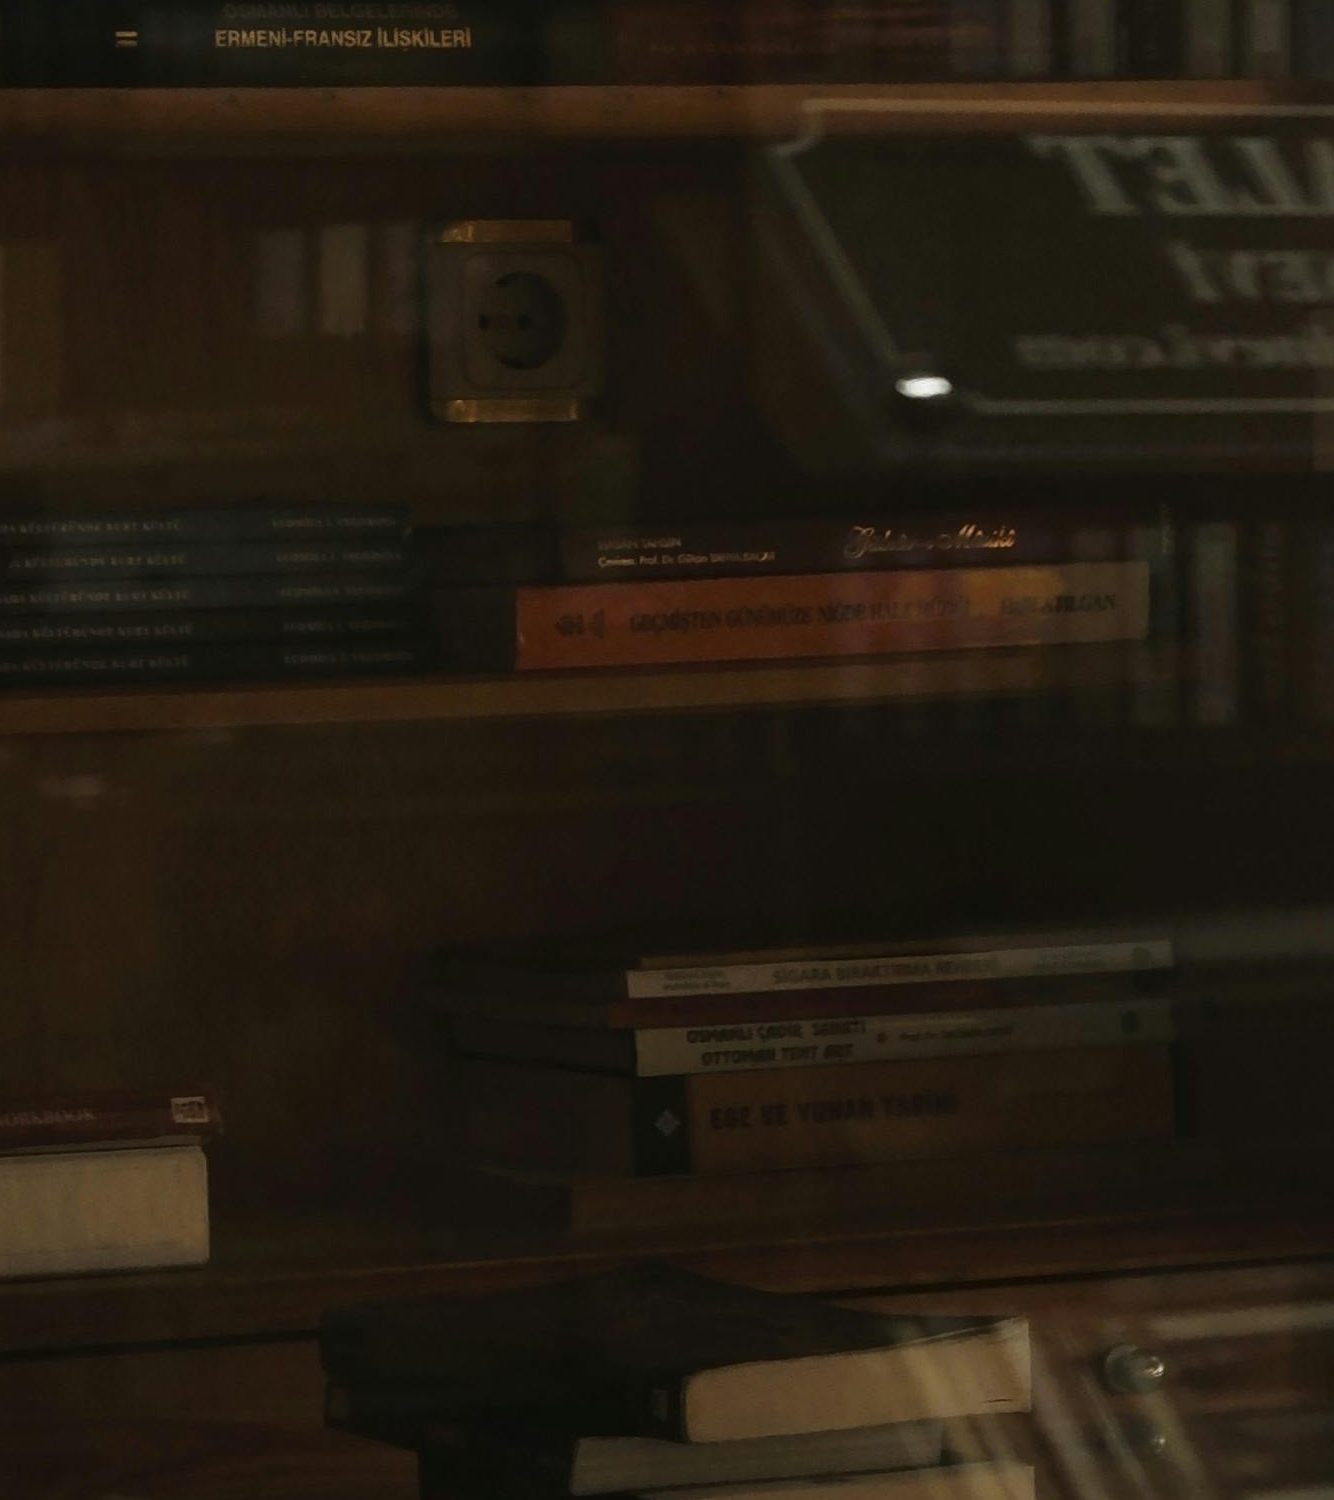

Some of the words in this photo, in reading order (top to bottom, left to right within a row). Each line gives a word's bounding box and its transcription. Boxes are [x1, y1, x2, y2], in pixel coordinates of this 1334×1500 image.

[214, 26, 374, 50] ERMENİ-FRANSIZ
[376, 25, 473, 52] İLİŞKİLERİ
[709, 1103, 754, 1132] EGE
[760, 1101, 790, 1127] VE
